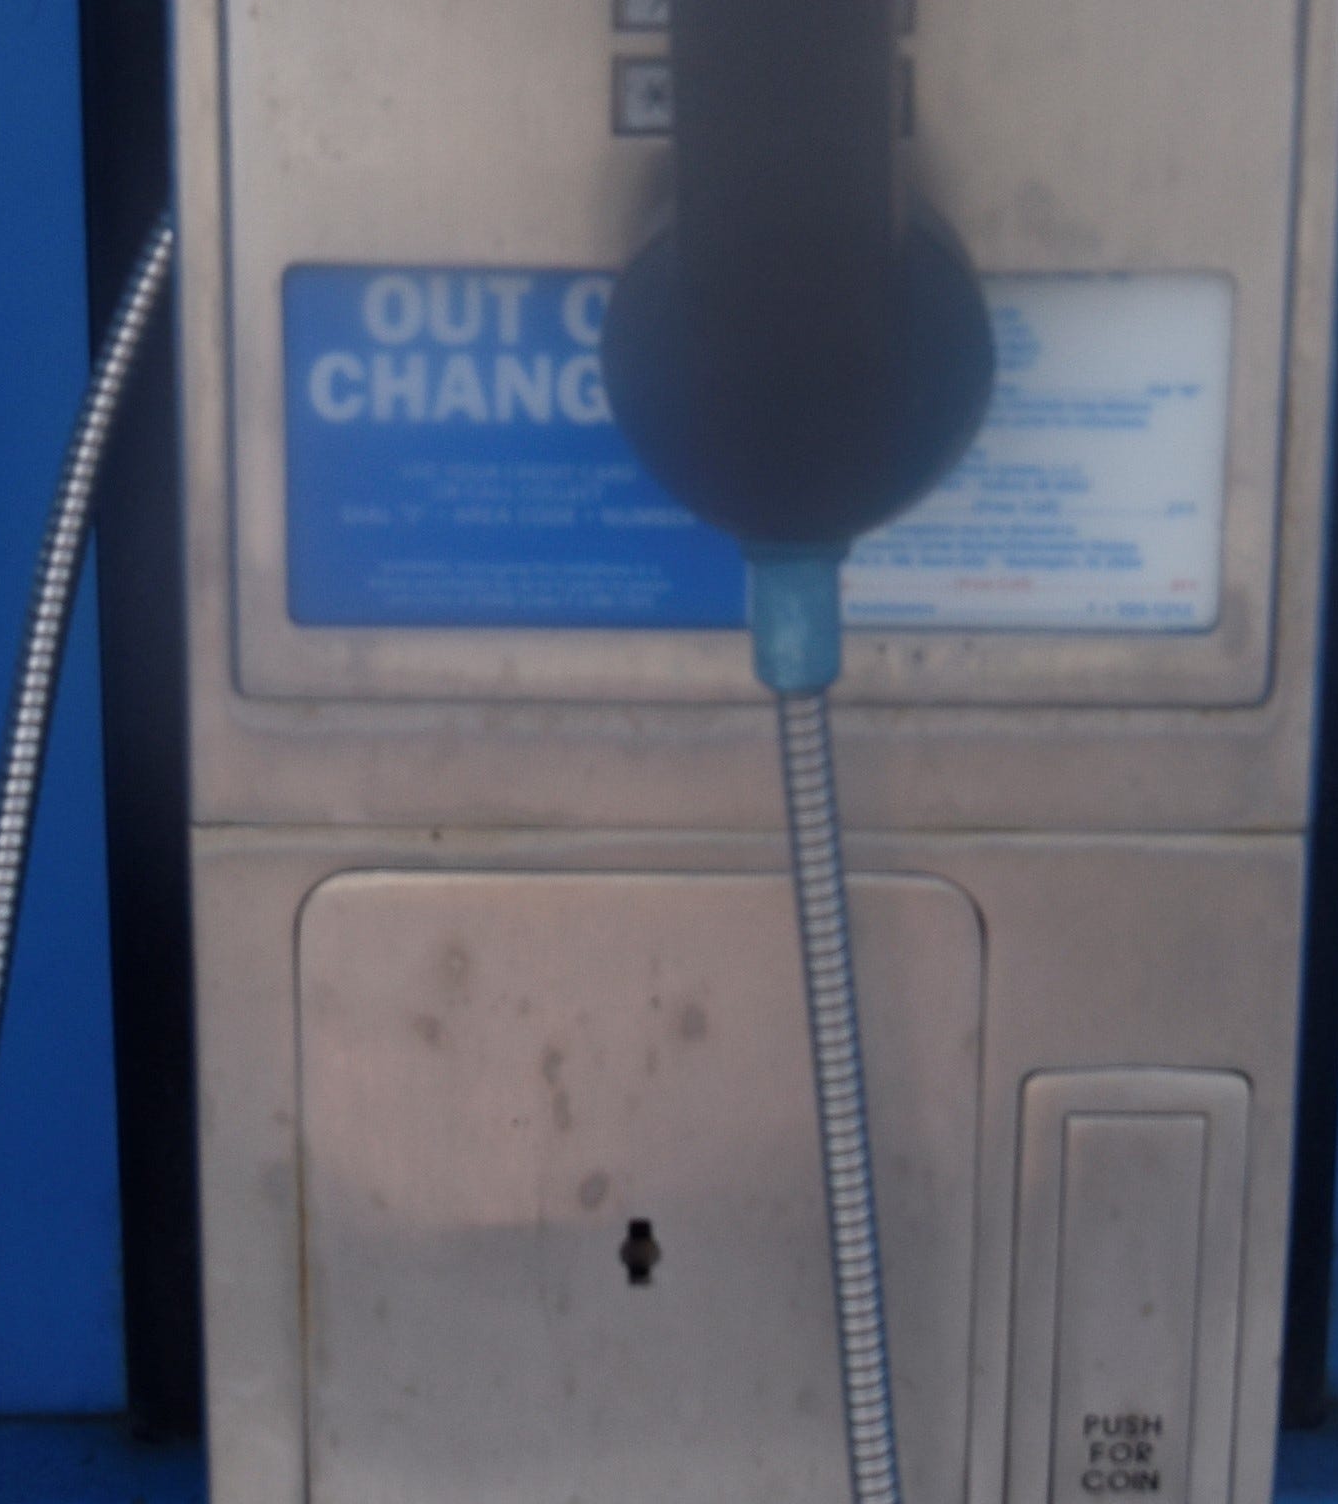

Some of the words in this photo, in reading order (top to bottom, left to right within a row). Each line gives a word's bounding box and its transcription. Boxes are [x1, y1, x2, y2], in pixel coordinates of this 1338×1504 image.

[363, 274, 532, 346] OUT
[562, 275, 614, 345] O
[308, 350, 614, 426] CHANG
[1083, 1413, 1163, 1437] PUSH
[1089, 1442, 1154, 1464] FOR
[1081, 1469, 1160, 1492] COIN
